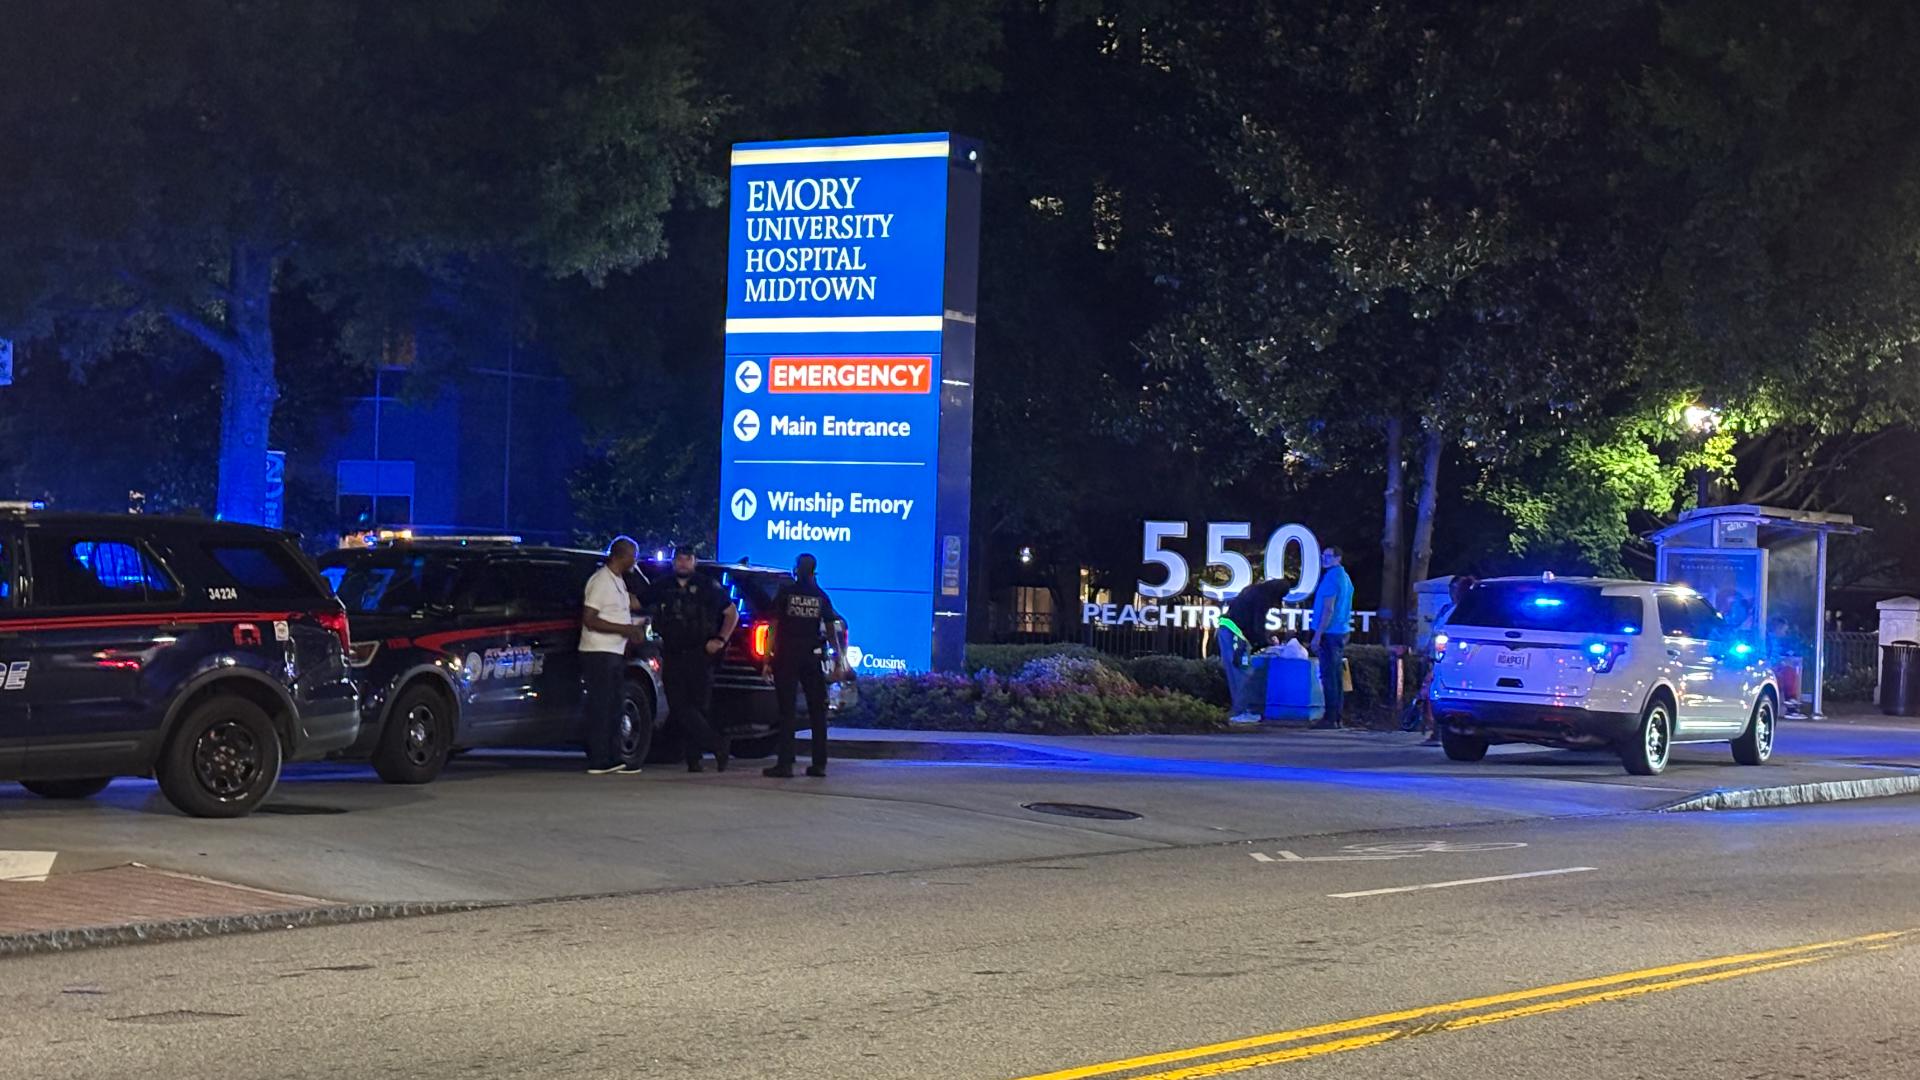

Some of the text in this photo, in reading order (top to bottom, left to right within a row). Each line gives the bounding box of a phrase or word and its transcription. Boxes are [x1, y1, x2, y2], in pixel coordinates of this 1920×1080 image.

[747, 177, 862, 212] EMORY
[746, 214, 894, 241] UNIVERSITY
[745, 246, 866, 272] HOSPITAL
[744, 276, 877, 302] MIDTOWN
[773, 364, 926, 387] EMERGENCY
[770, 415, 911, 437] Main Entrance
[767, 491, 914, 520] Winship Emory
[767, 519, 851, 542] Midtown
[1137, 520, 1322, 602] 550
[208, 587, 238, 600] 34224
[790, 595, 820, 607] ATLANTA
[787, 605, 820, 618] POLICE
[1082, 603, 1229, 629] PEACHTR
[863, 653, 907, 670] Cousins
